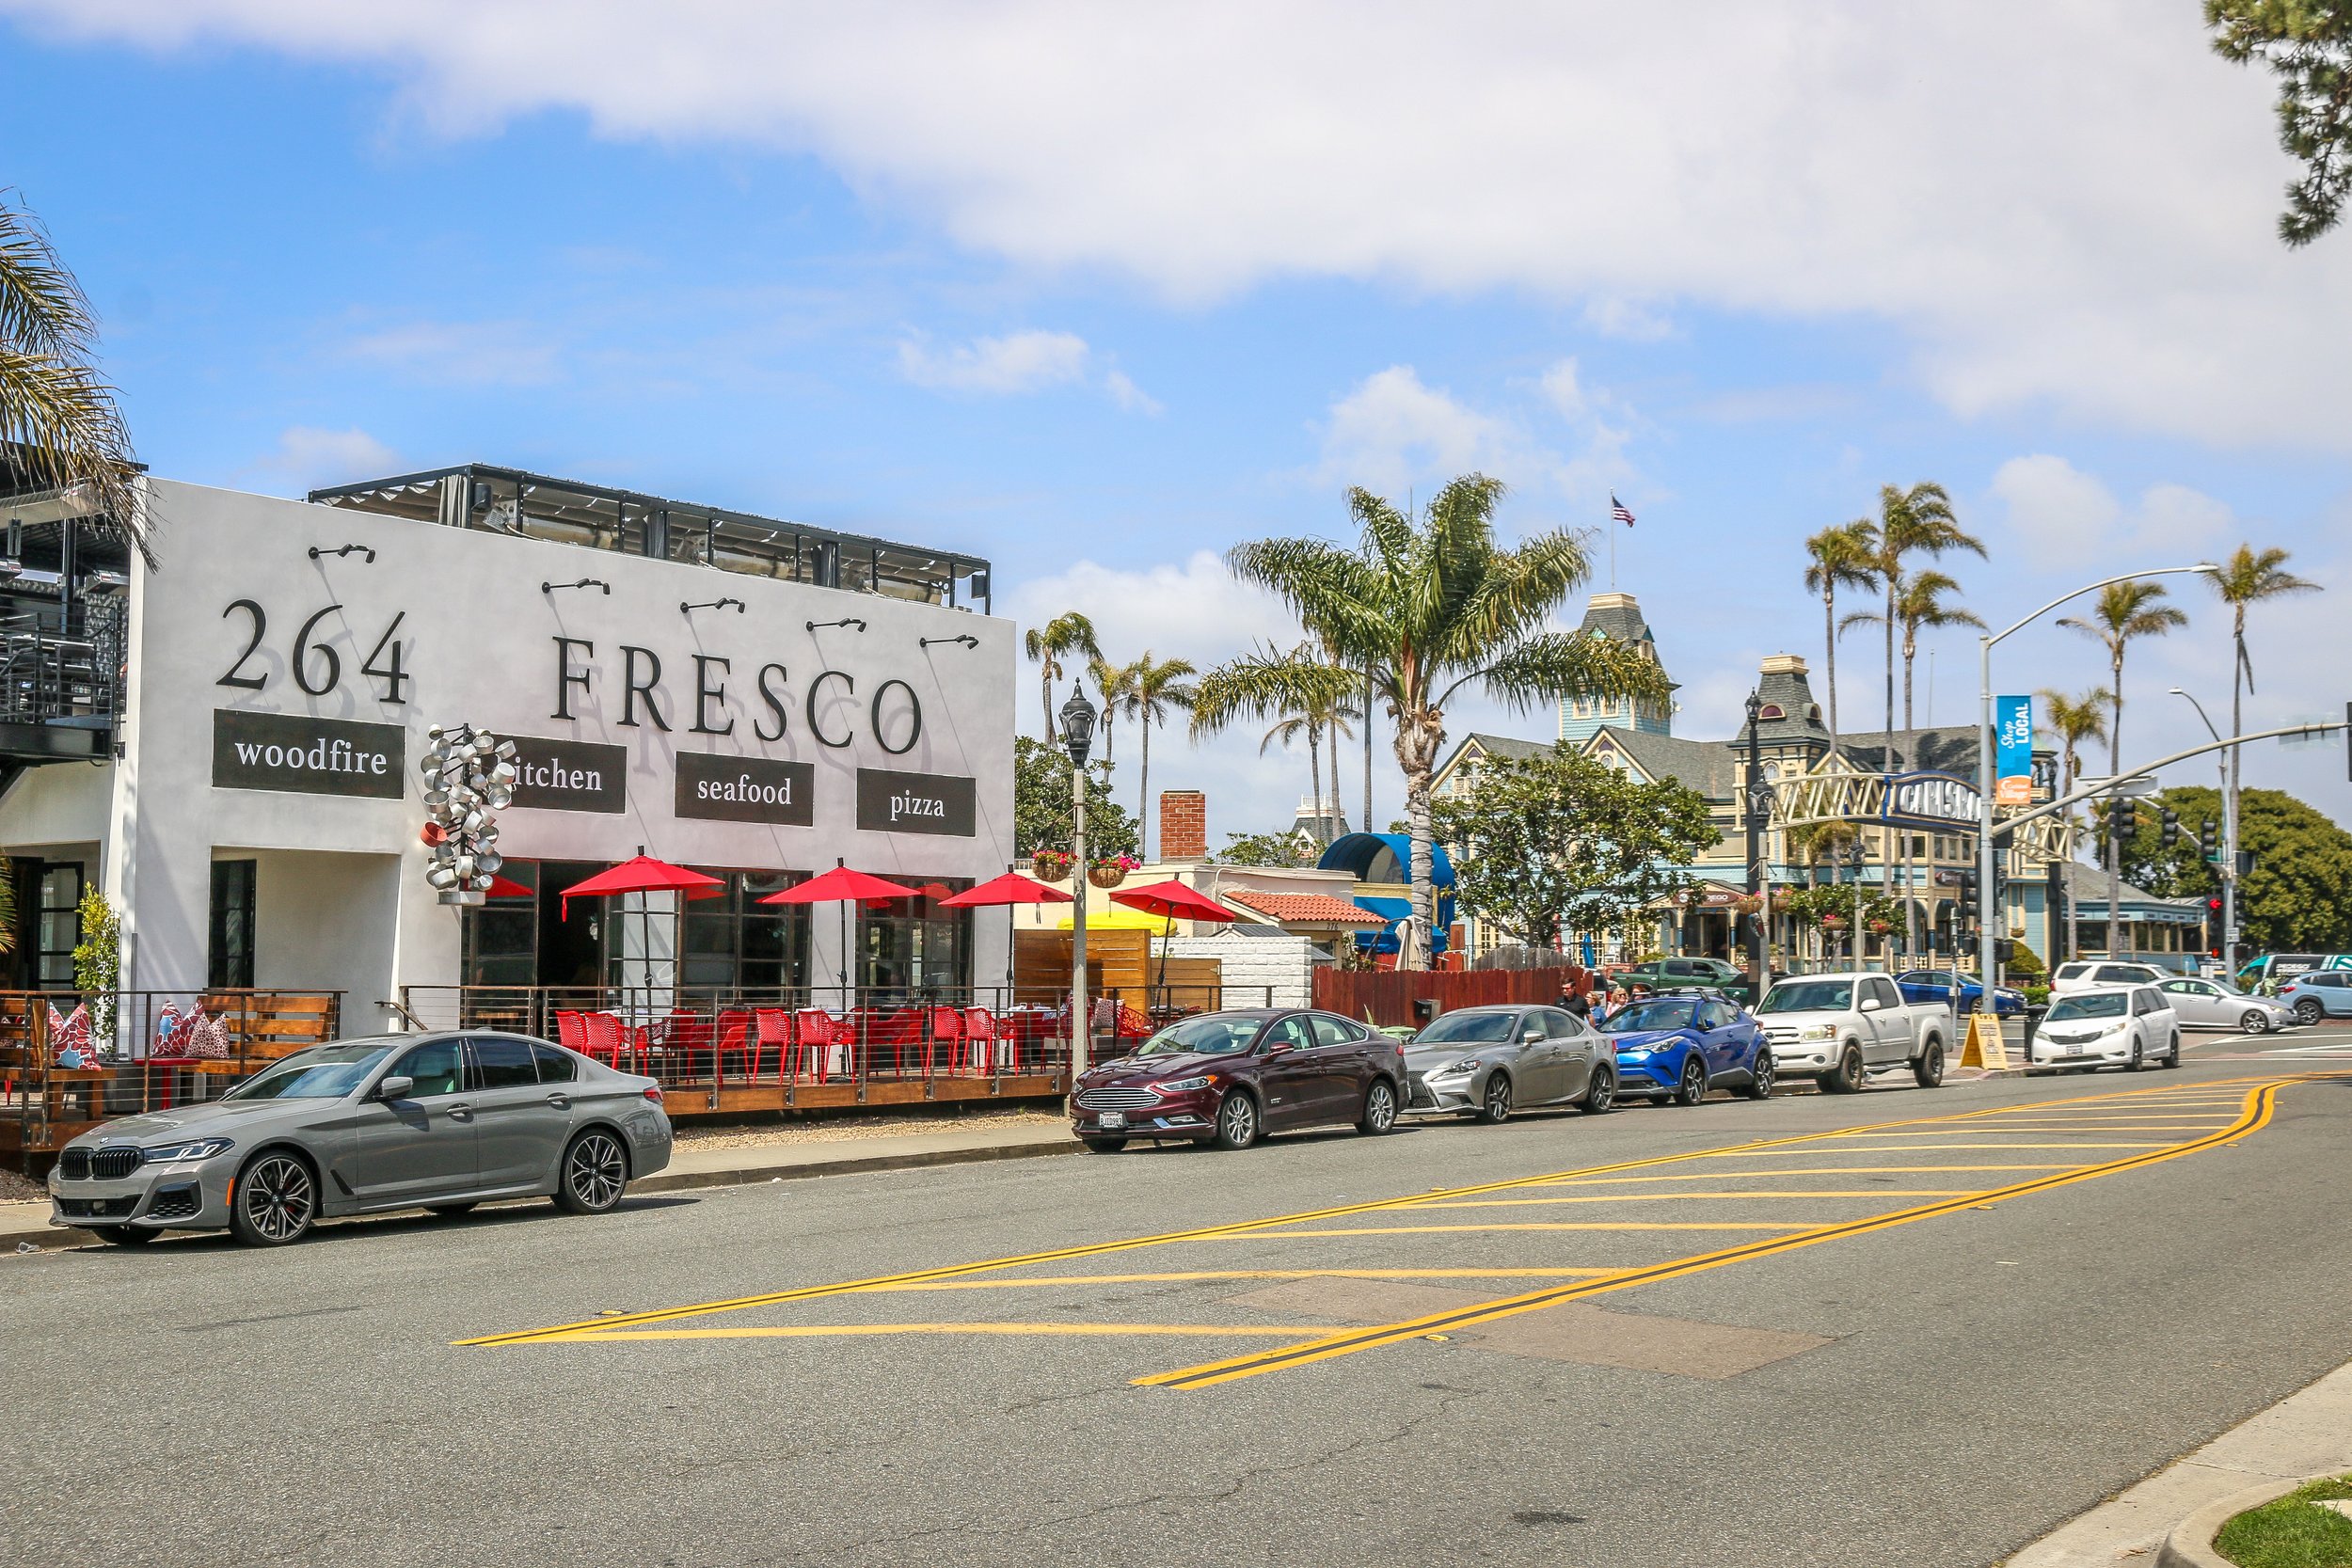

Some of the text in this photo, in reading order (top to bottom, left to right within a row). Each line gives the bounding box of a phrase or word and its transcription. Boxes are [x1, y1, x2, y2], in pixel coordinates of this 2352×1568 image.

[215, 598, 922, 754] 264 FRESCO
[2000, 721, 2017, 749] Shop
[2015, 703, 2029, 744] LOCAL
[234, 737, 387, 775] woodfire
[496, 753, 602, 791] itchen
[697, 774, 792, 805] seafood
[889, 789, 946, 821] pizza
[1327, 922, 1339, 930] 276
